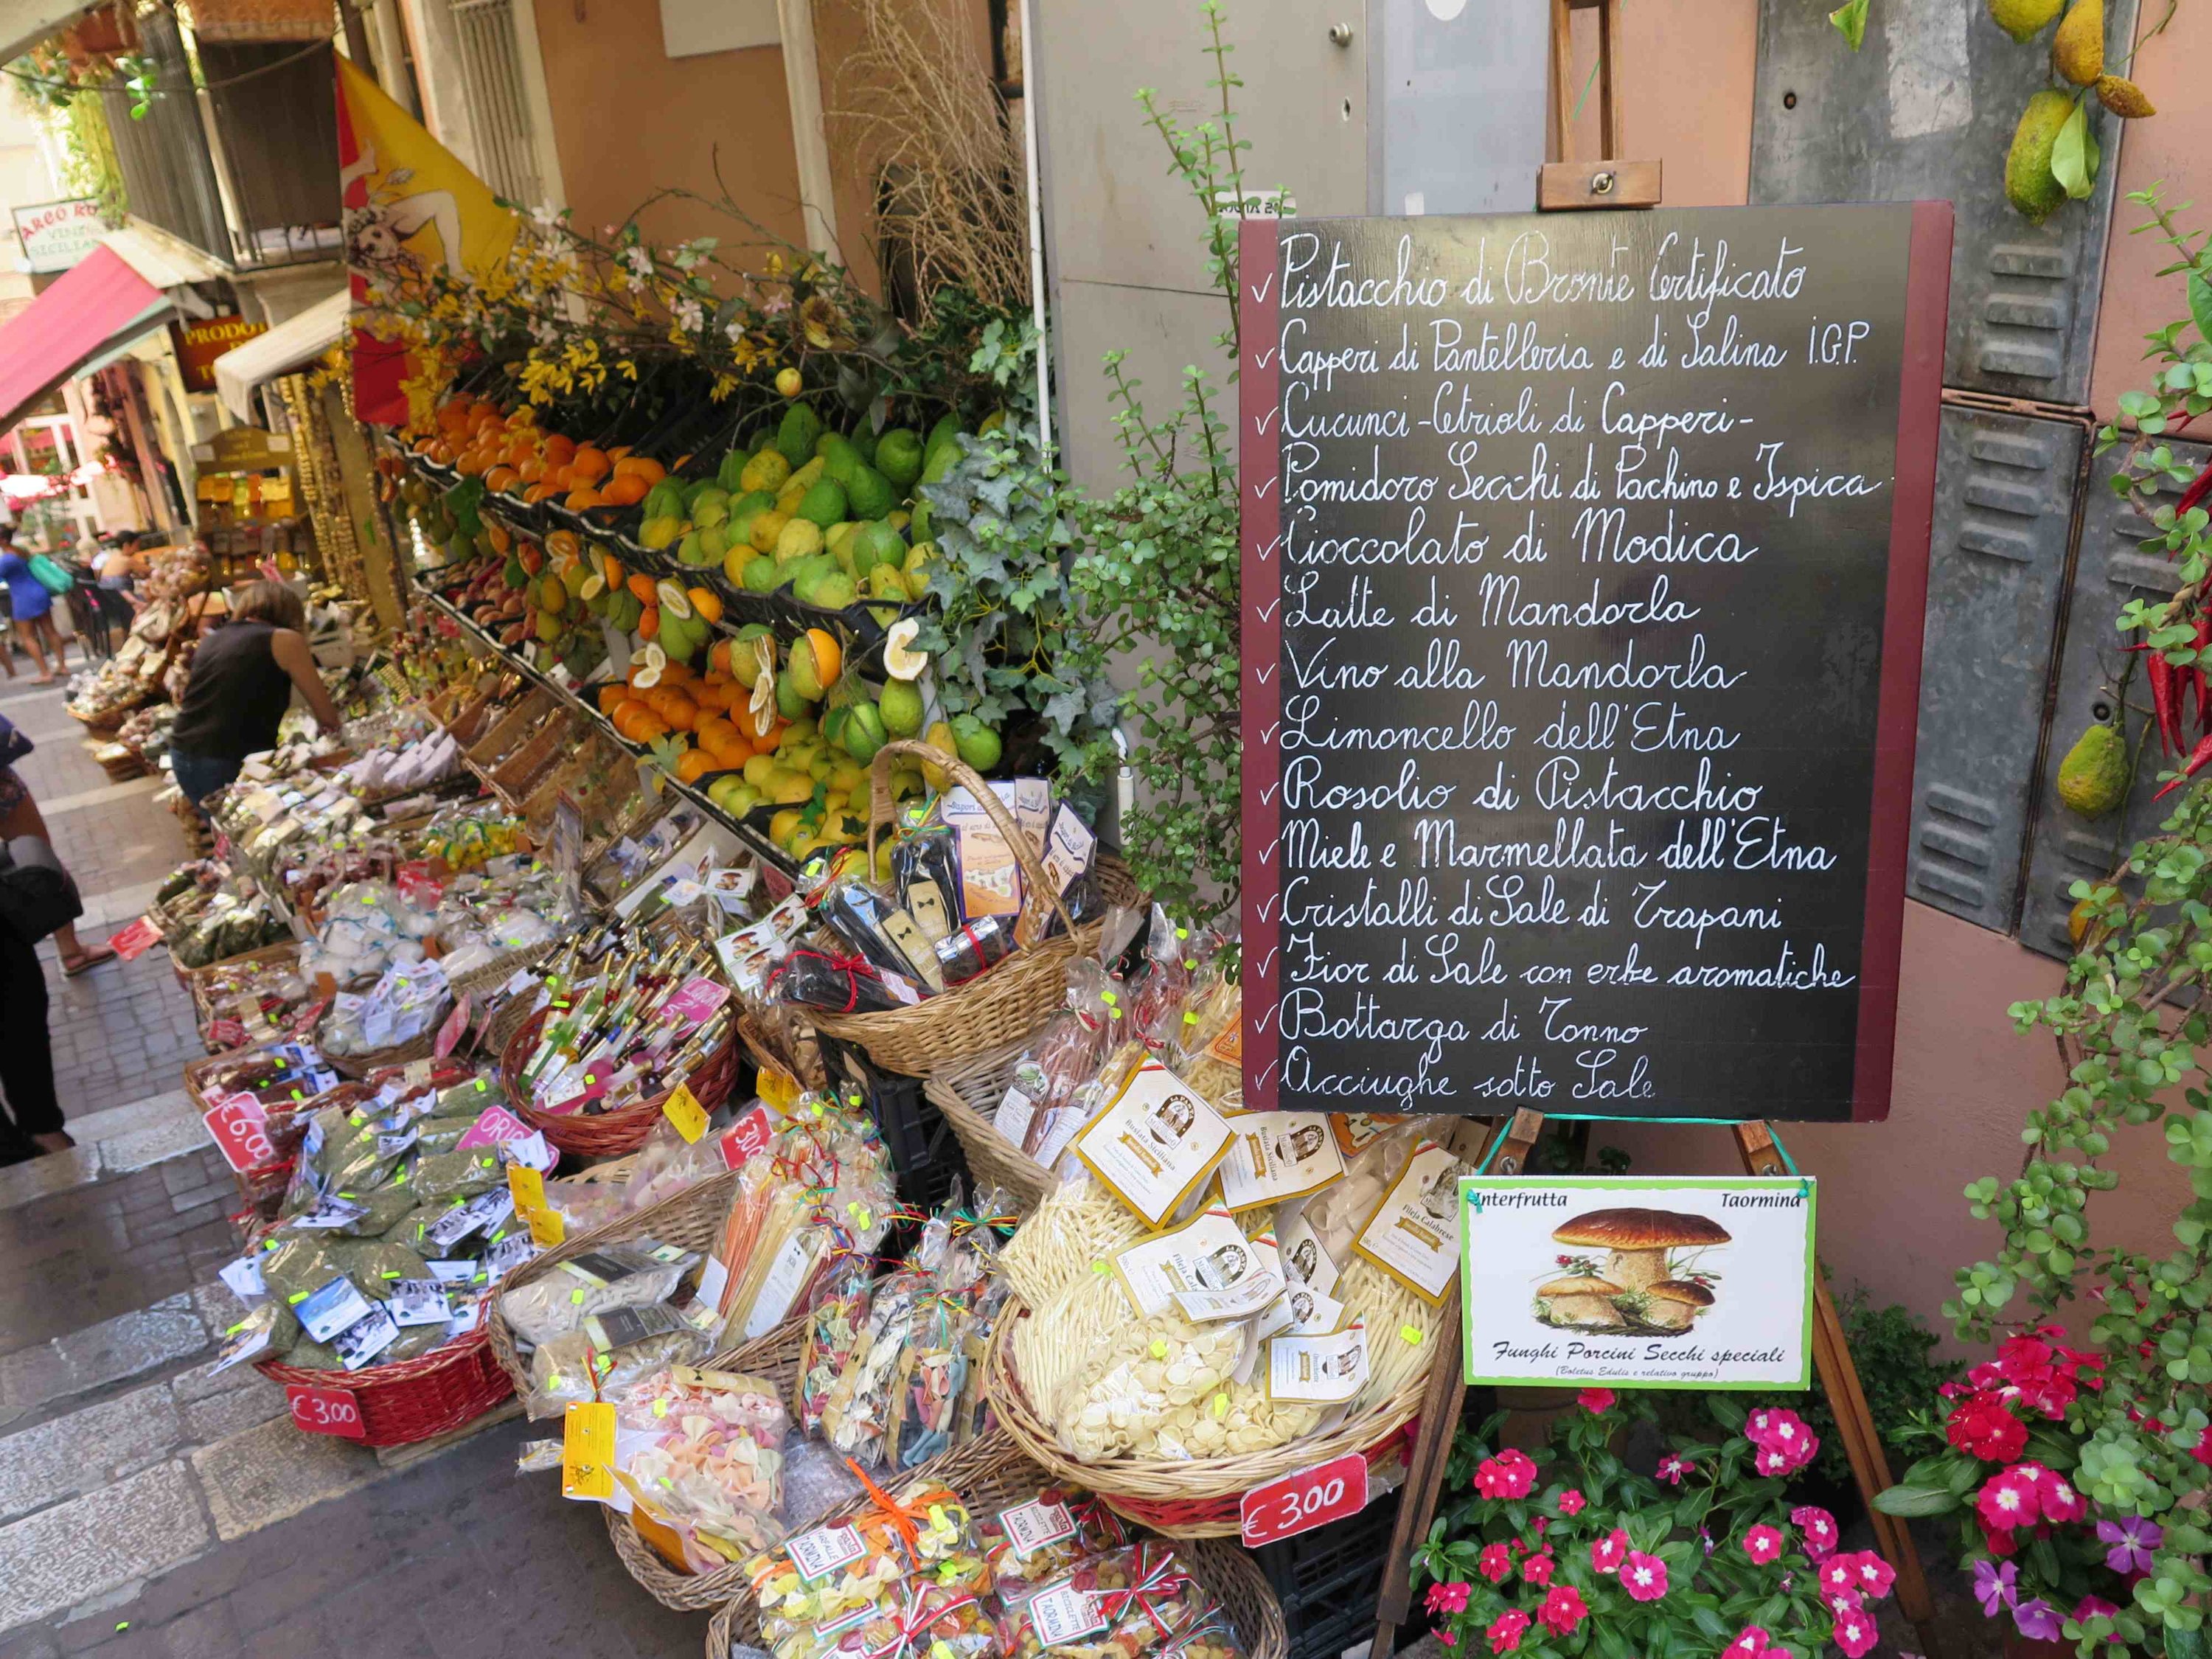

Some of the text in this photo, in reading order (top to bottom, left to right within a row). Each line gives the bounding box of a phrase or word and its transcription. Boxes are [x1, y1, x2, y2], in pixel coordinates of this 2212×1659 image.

[1280, 232, 1806, 318] Pistacchio di Bronte Certificato
[1279, 319, 1379, 392] Capperi
[1388, 323, 1419, 371] di
[1429, 319, 1593, 372] Pantelleria
[1608, 348, 1625, 369] e
[1638, 314, 1667, 368] di
[1683, 313, 1787, 371] Salina
[1281, 381, 1410, 438] Cucunci
[1549, 387, 1587, 434] di
[1281, 442, 1439, 504] Pomidoro
[1448, 441, 1562, 501] Secchi
[1570, 442, 1601, 501] di
[1615, 445, 1719, 503] Pachino
[1727, 477, 1742, 499] e
[1278, 505, 1759, 565] Cioccolato di Modica
[1284, 571, 1701, 628] Latte di Mandorla
[1285, 633, 1747, 689] Vino alla Mandorla
[1280, 695, 1517, 751] Limoncello
[1284, 755, 1763, 811] Rosolio di Pistacchio
[1281, 818, 1371, 869] Miele
[1380, 844, 1396, 867] e
[1414, 817, 1648, 868] Marmellata
[1279, 874, 1781, 950] Cristalli di Sale di Trapani
[1287, 932, 1856, 990] Fior di Sale con erbe aromatiche
[1279, 988, 1648, 1063] Bottarga di Tonno
[1280, 1046, 1655, 1113] Acciughe sotto Sale
[1124, 1119, 1150, 1147] Busiata
[1147, 1142, 1176, 1172] Siciliana
[1259, 1126, 1279, 1181] Busiata Siciliana
[1402, 1203, 1420, 1220] Fileja
[1421, 1215, 1455, 1241] Calabrese
[1473, 1192, 1801, 1209] Interfrutta Taormina
[1492, 1340, 1785, 1366] Funghi Porcini Secchi speciali
[1555, 1365, 1594, 1377] (Boletus
[1598, 1366, 1630, 1377] Edulis
[1641, 1368, 1677, 1377] relativo
[1680, 1368, 1719, 1381] gruppo)
[290, 1394, 312, 1422] €
[817, 1531, 841, 1561] FARFALLE
[1242, 1504, 1267, 1538] €
